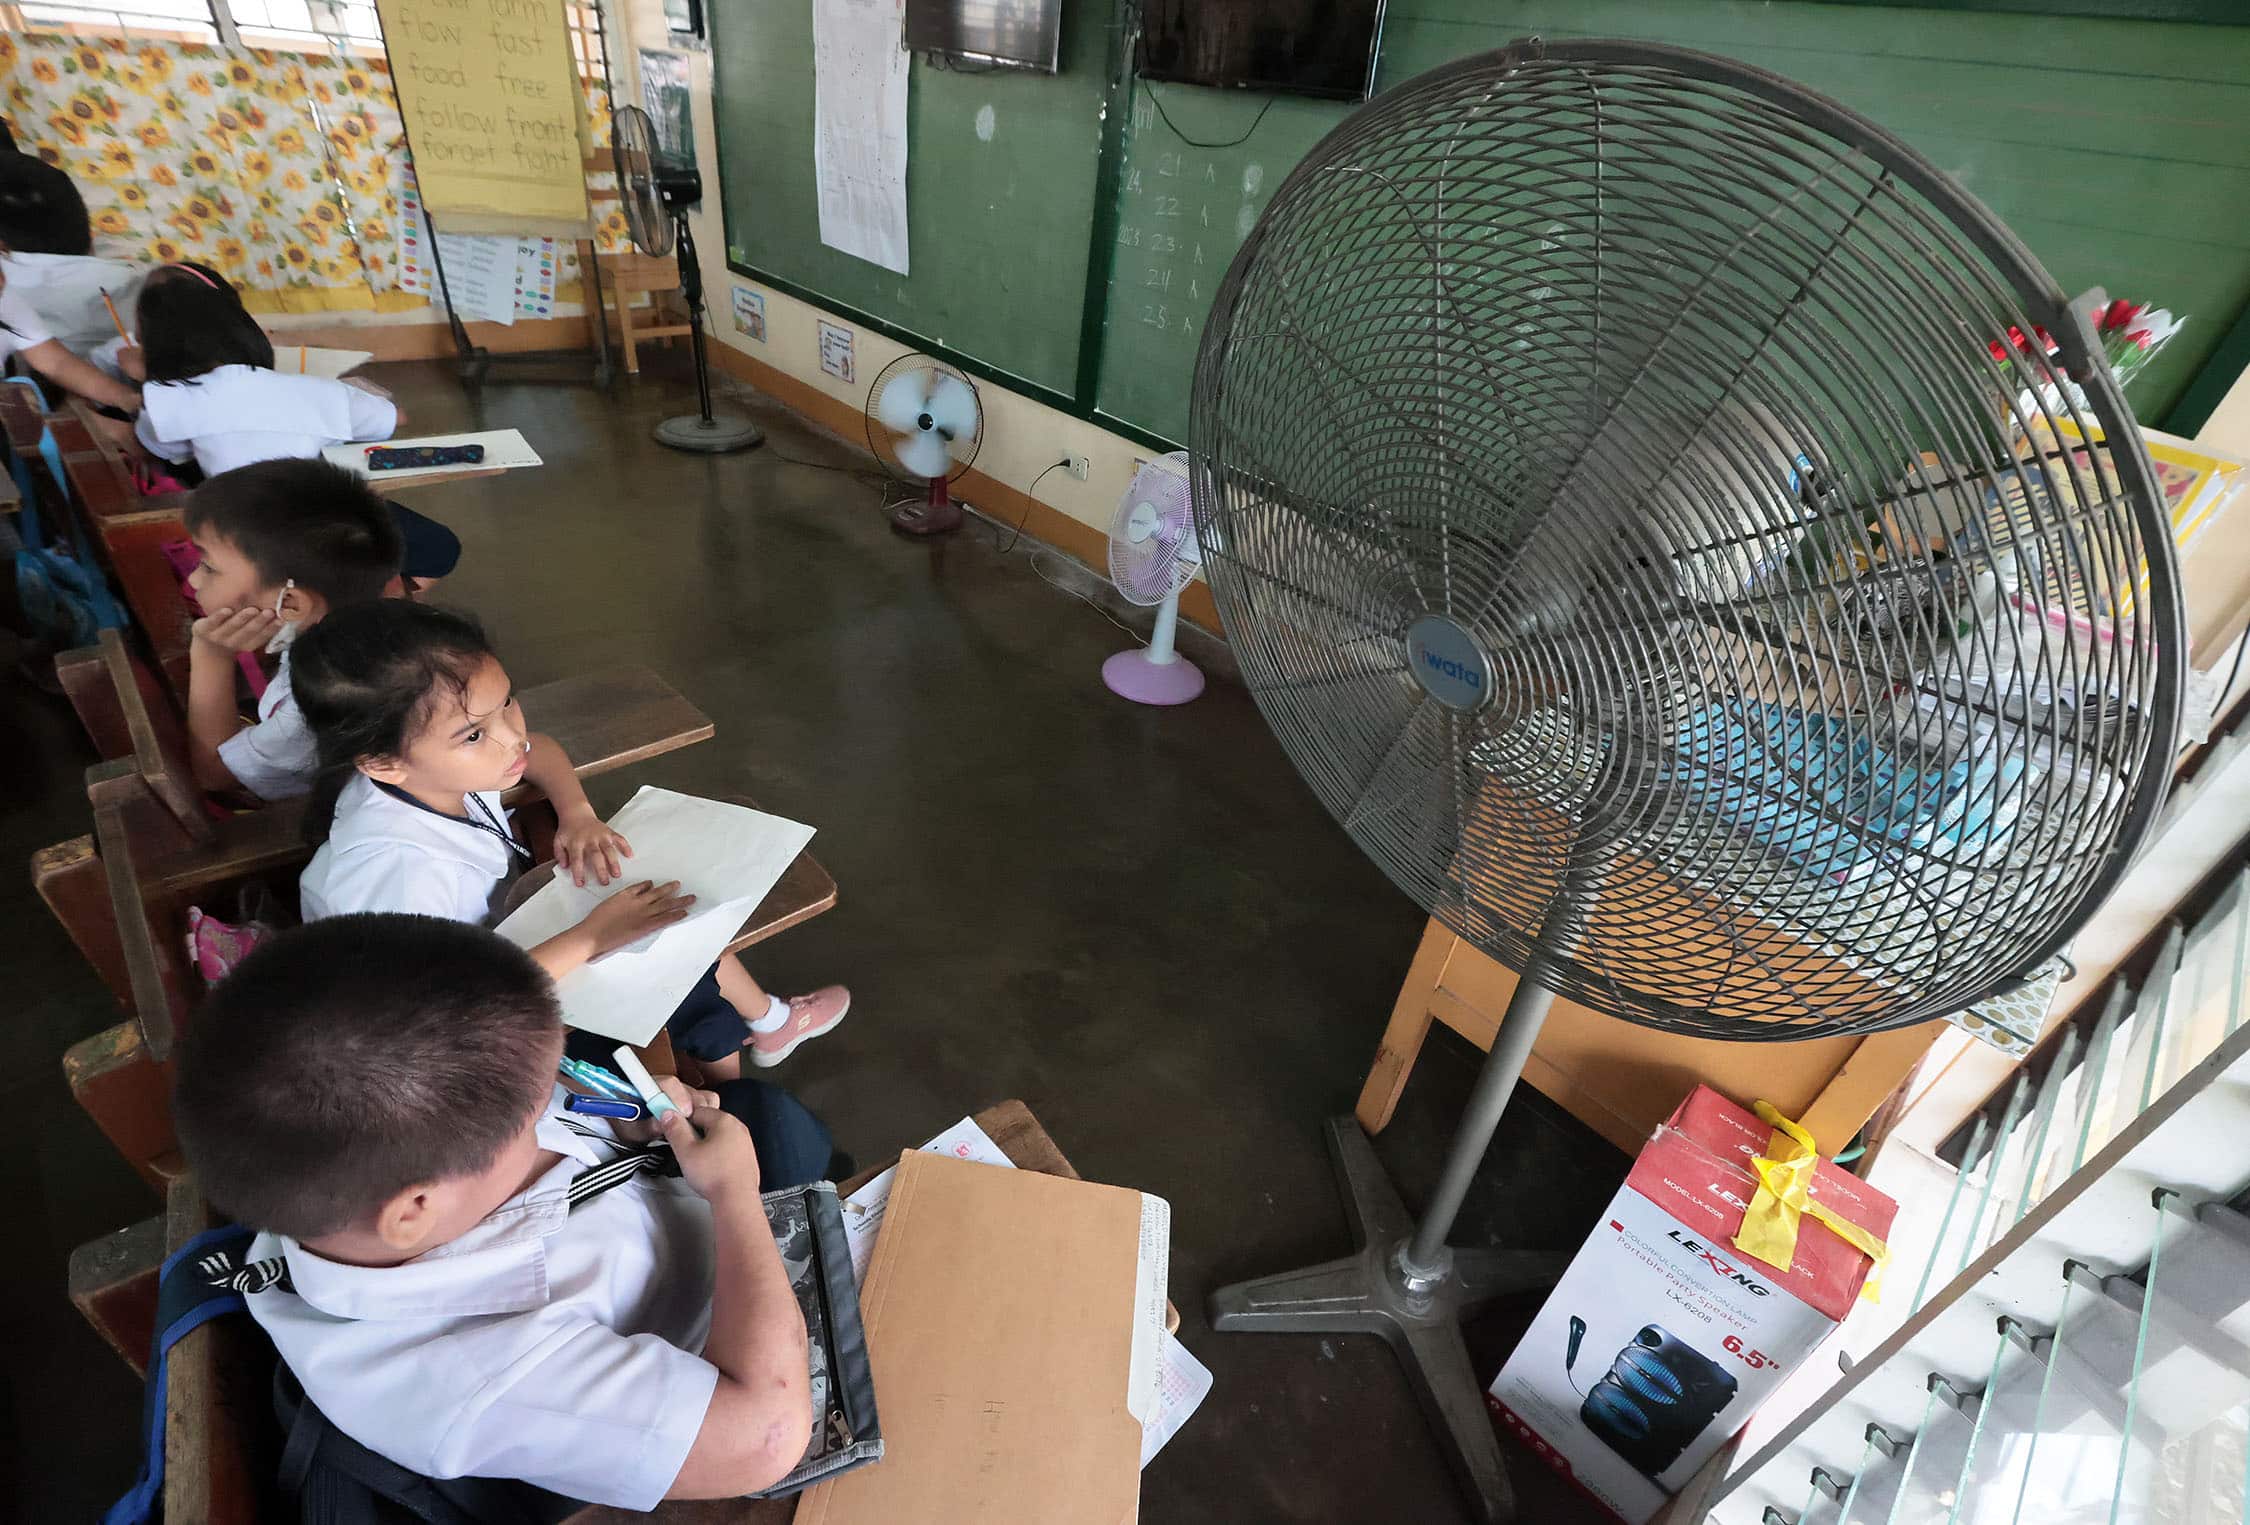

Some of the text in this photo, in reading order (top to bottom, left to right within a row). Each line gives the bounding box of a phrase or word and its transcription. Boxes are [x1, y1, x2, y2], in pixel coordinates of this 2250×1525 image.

[400, 8, 544, 56] flow fast
[409, 53, 548, 98] food free
[416, 96, 568, 141] follow front
[423, 132, 497, 163] forget
[1617, 1236, 1747, 1331] Portable Party Speaker
[1667, 1230, 1771, 1297] LEXING
[1791, 1260, 1816, 1280] LACK
